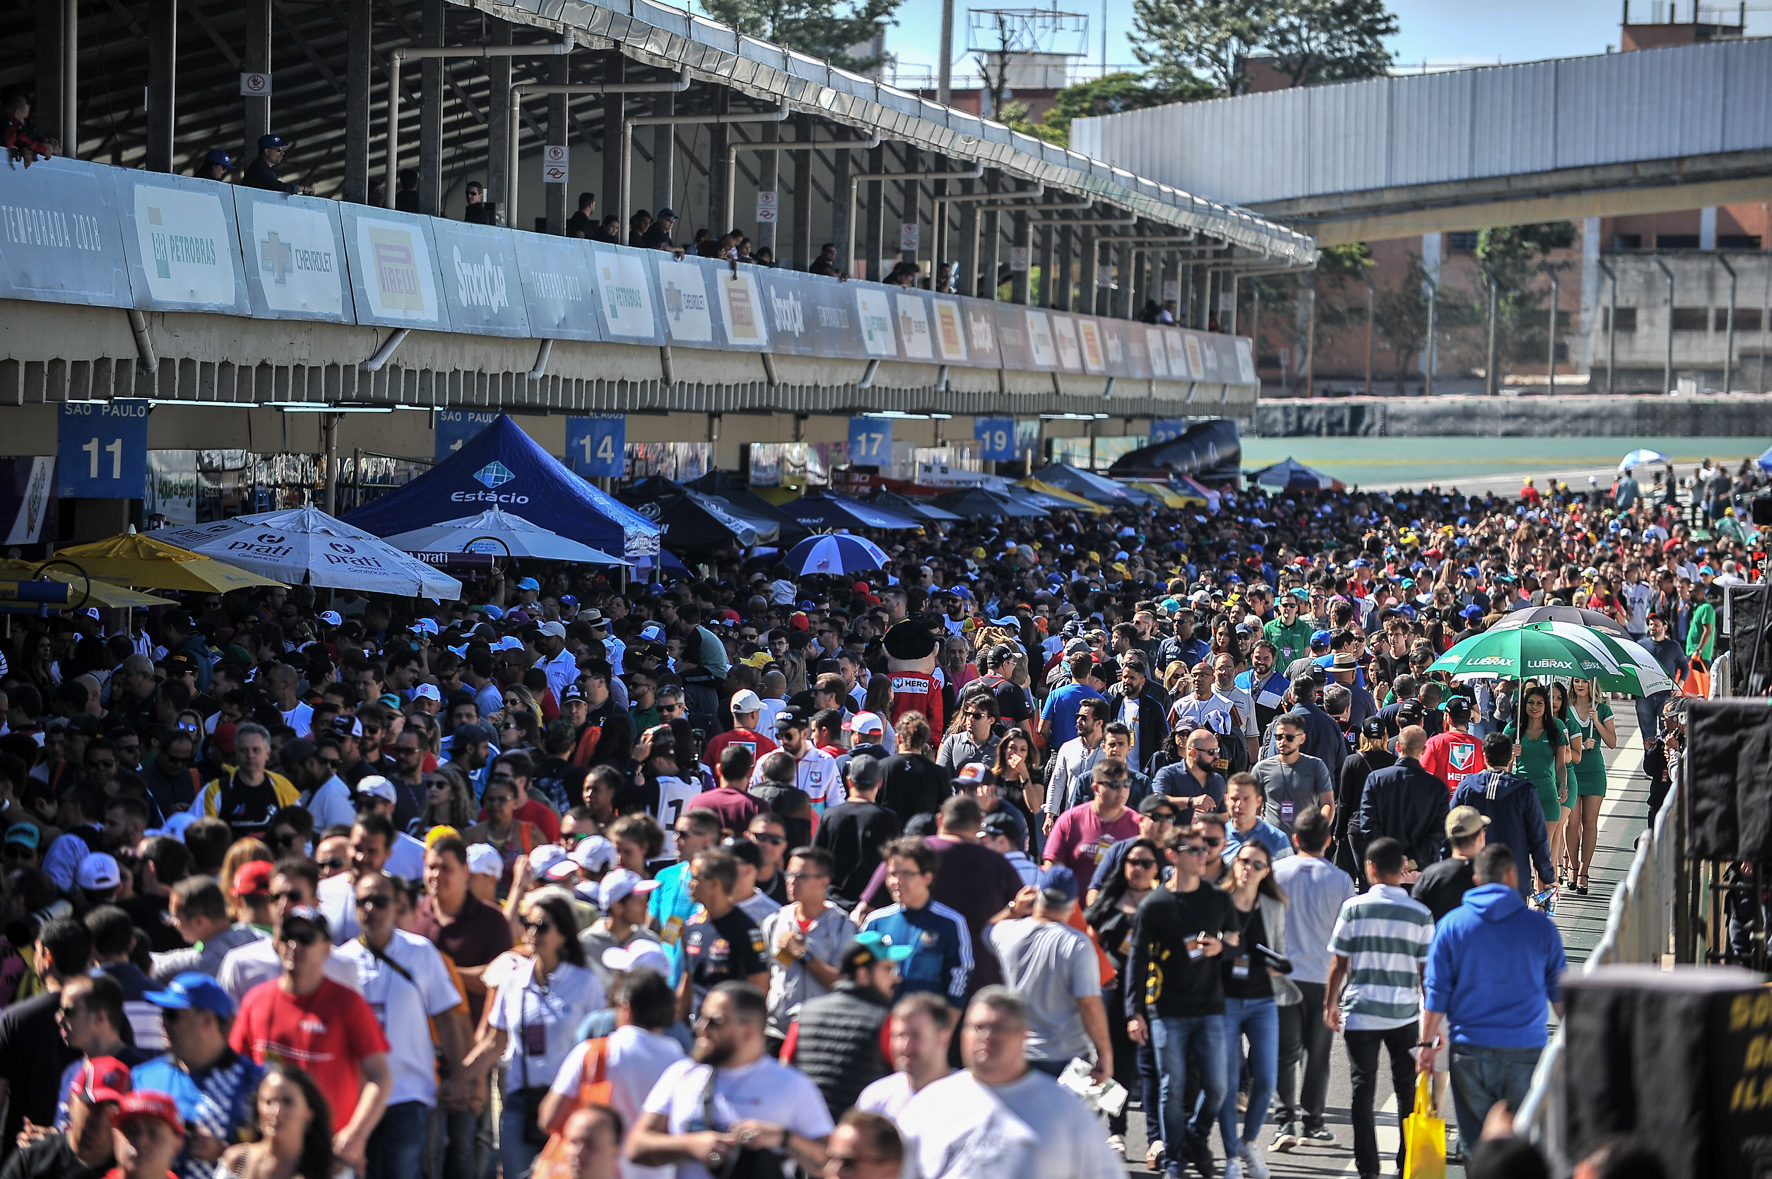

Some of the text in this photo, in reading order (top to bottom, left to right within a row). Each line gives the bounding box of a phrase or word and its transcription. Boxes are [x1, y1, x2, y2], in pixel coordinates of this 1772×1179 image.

[2, 205, 101, 251] TEMPORADA 2018
[169, 234, 216, 266] PETROBRAS
[295, 248, 333, 273] CHEVROLET
[374, 242, 418, 296] PIRELLI
[728, 288, 754, 326] PIRELLI
[101, 404, 146, 418] PAULO
[579, 434, 614, 464] 14
[857, 432, 884, 456] 17
[982, 430, 1007, 452] 19
[82, 437, 122, 479] 11
[450, 490, 529, 505] Estácio
[227, 541, 294, 556] prati
[323, 551, 383, 569] prati
[417, 551, 448, 565] prati
[1466, 656, 1516, 668] LUBRAX
[1527, 660, 1573, 670] LUBRAX
[905, 680, 928, 688] HERO
[664, 799, 684, 831] 1
